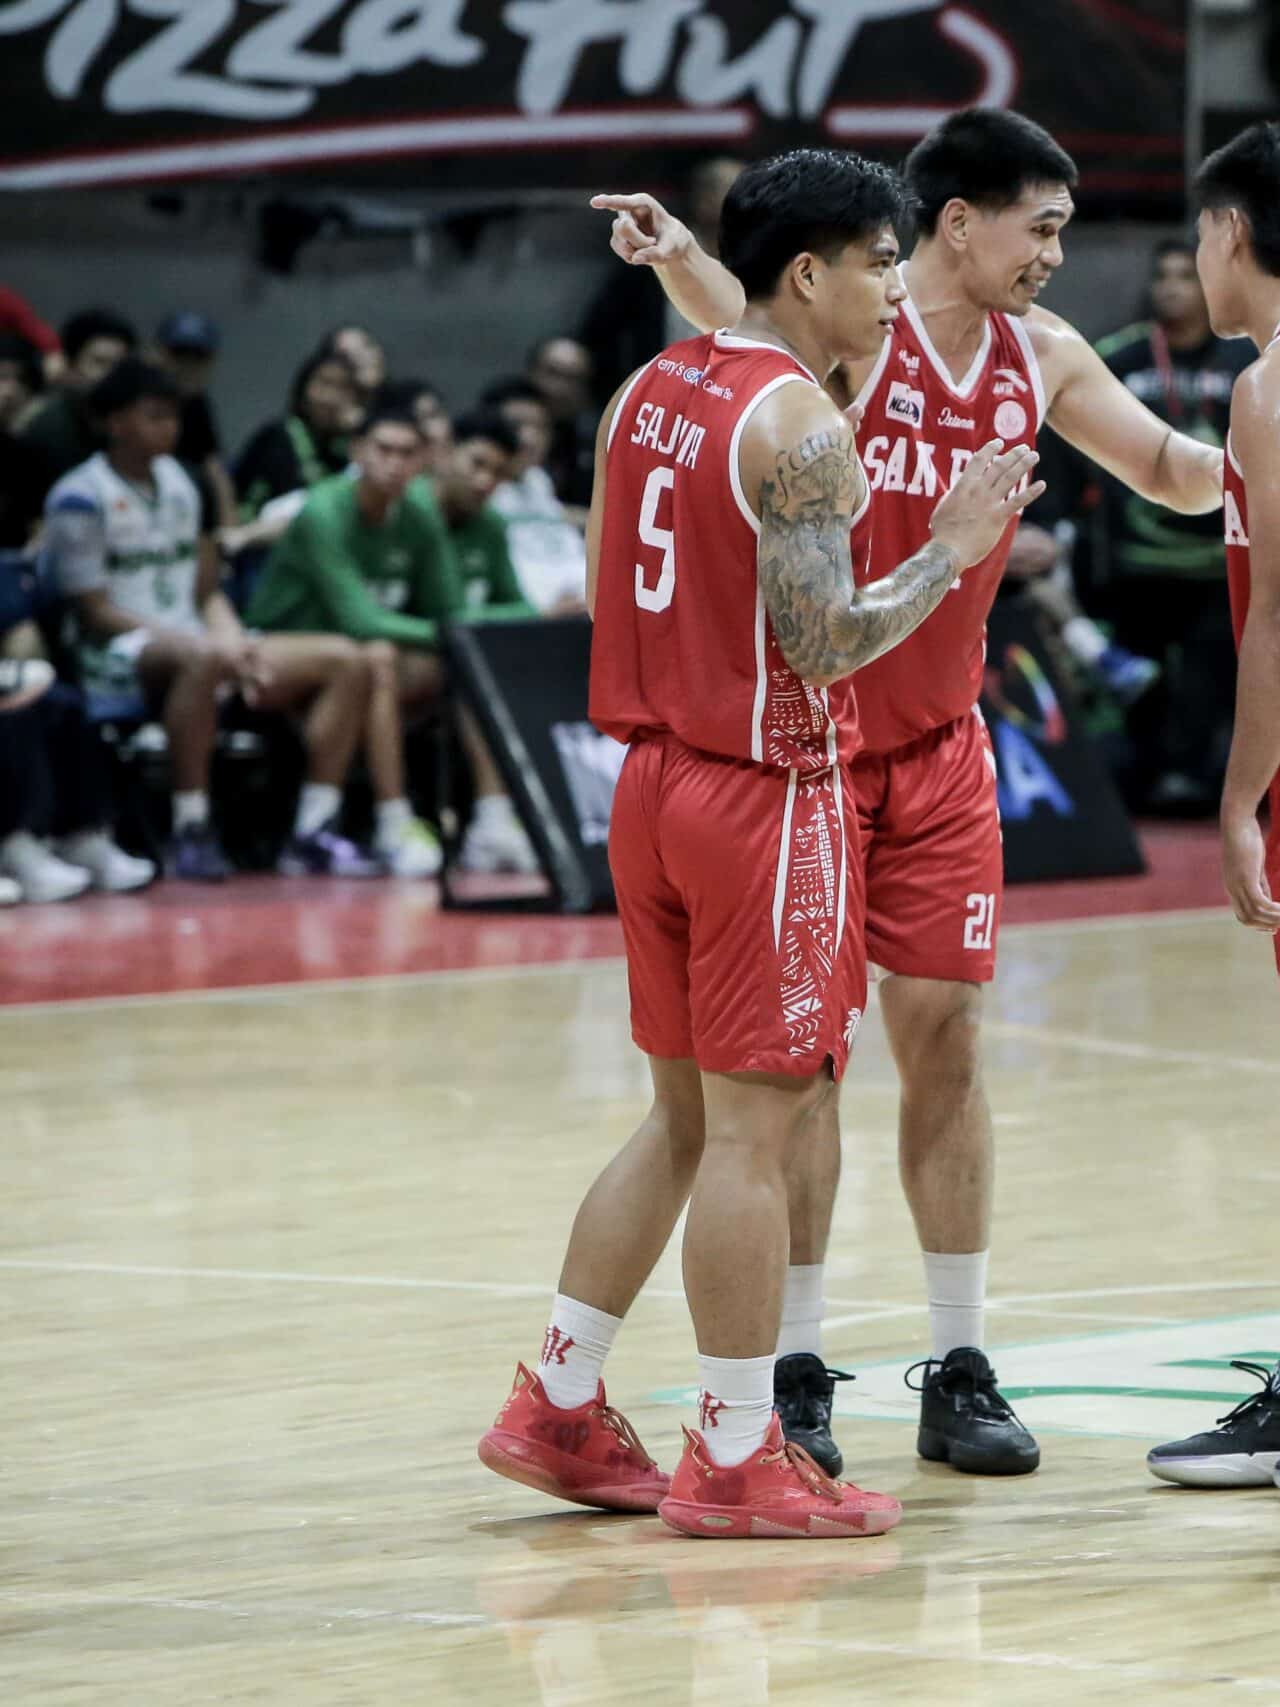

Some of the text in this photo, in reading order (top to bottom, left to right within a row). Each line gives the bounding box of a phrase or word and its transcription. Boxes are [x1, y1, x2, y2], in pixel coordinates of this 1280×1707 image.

[0, 0, 484, 118] izza
[864, 436, 938, 497] SAN
[634, 466, 676, 613] 5
[963, 893, 995, 949] 21
